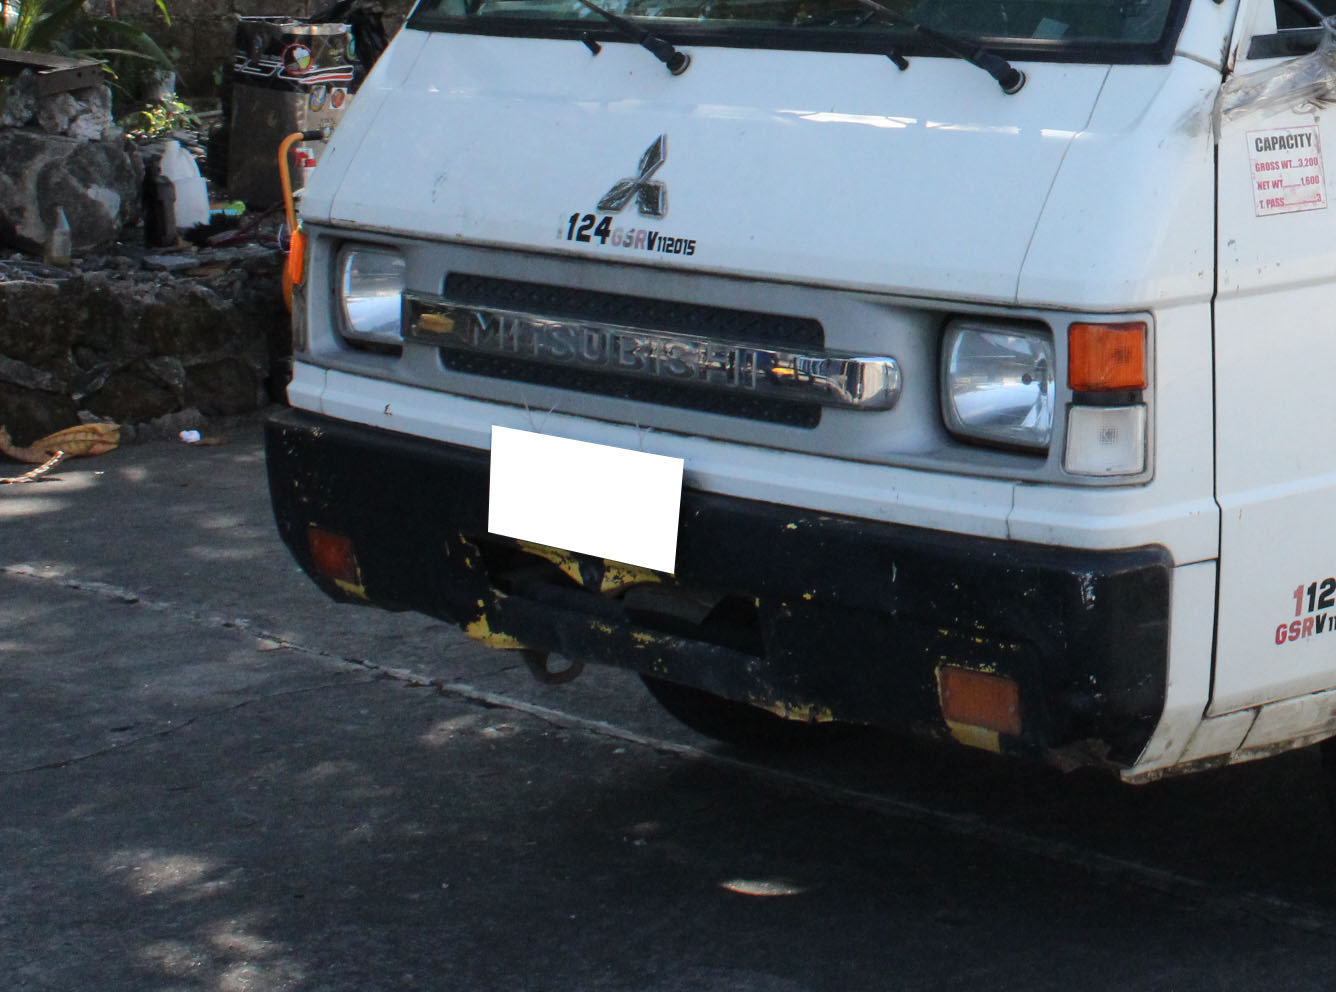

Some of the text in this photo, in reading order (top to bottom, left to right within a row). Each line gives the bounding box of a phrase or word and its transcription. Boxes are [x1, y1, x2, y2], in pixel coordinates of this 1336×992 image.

[1255, 133, 1312, 152] CAPACITY
[1255, 160, 1280, 172] GROSS
[1256, 181, 1270, 191] NET
[470, 310, 759, 391] MITSUBISHI
